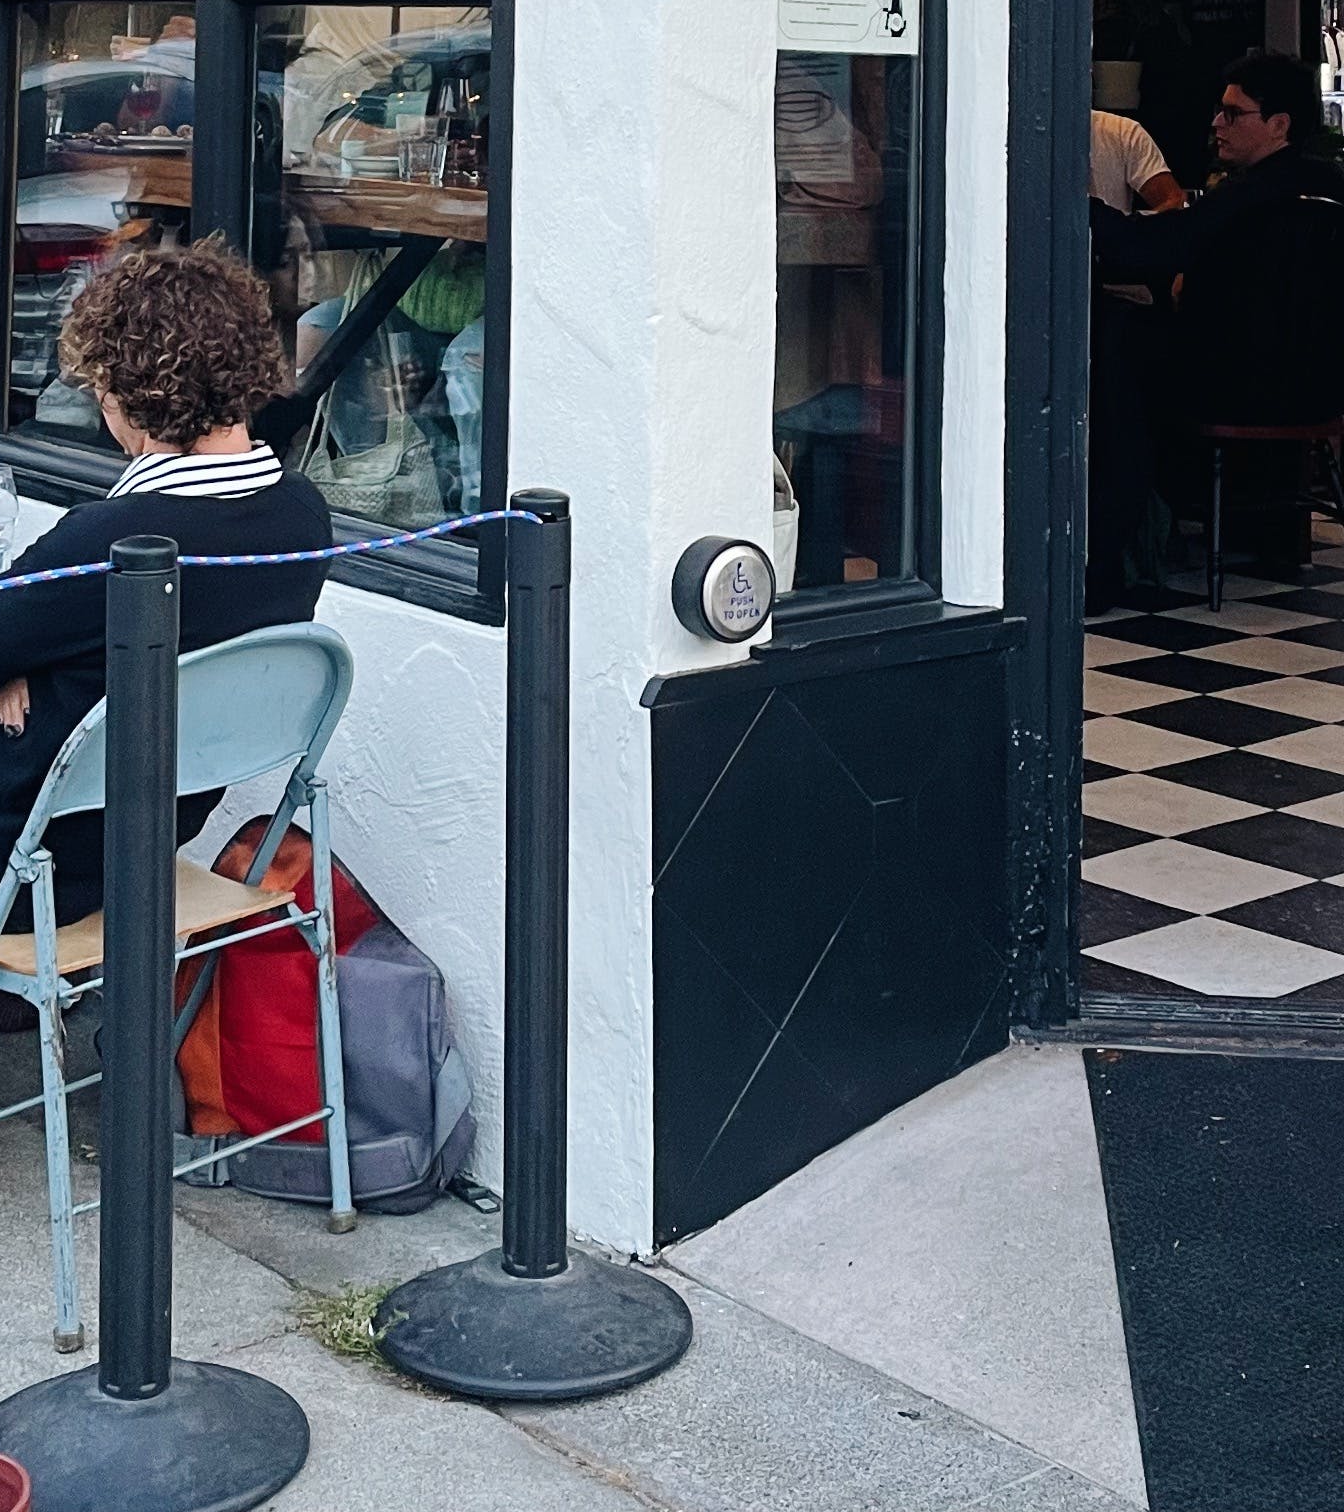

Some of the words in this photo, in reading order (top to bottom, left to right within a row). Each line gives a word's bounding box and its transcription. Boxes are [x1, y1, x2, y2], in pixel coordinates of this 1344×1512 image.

[730, 596, 754, 606] PUSH
[724, 609, 735, 620] TO
[737, 607, 761, 619] OPEN
